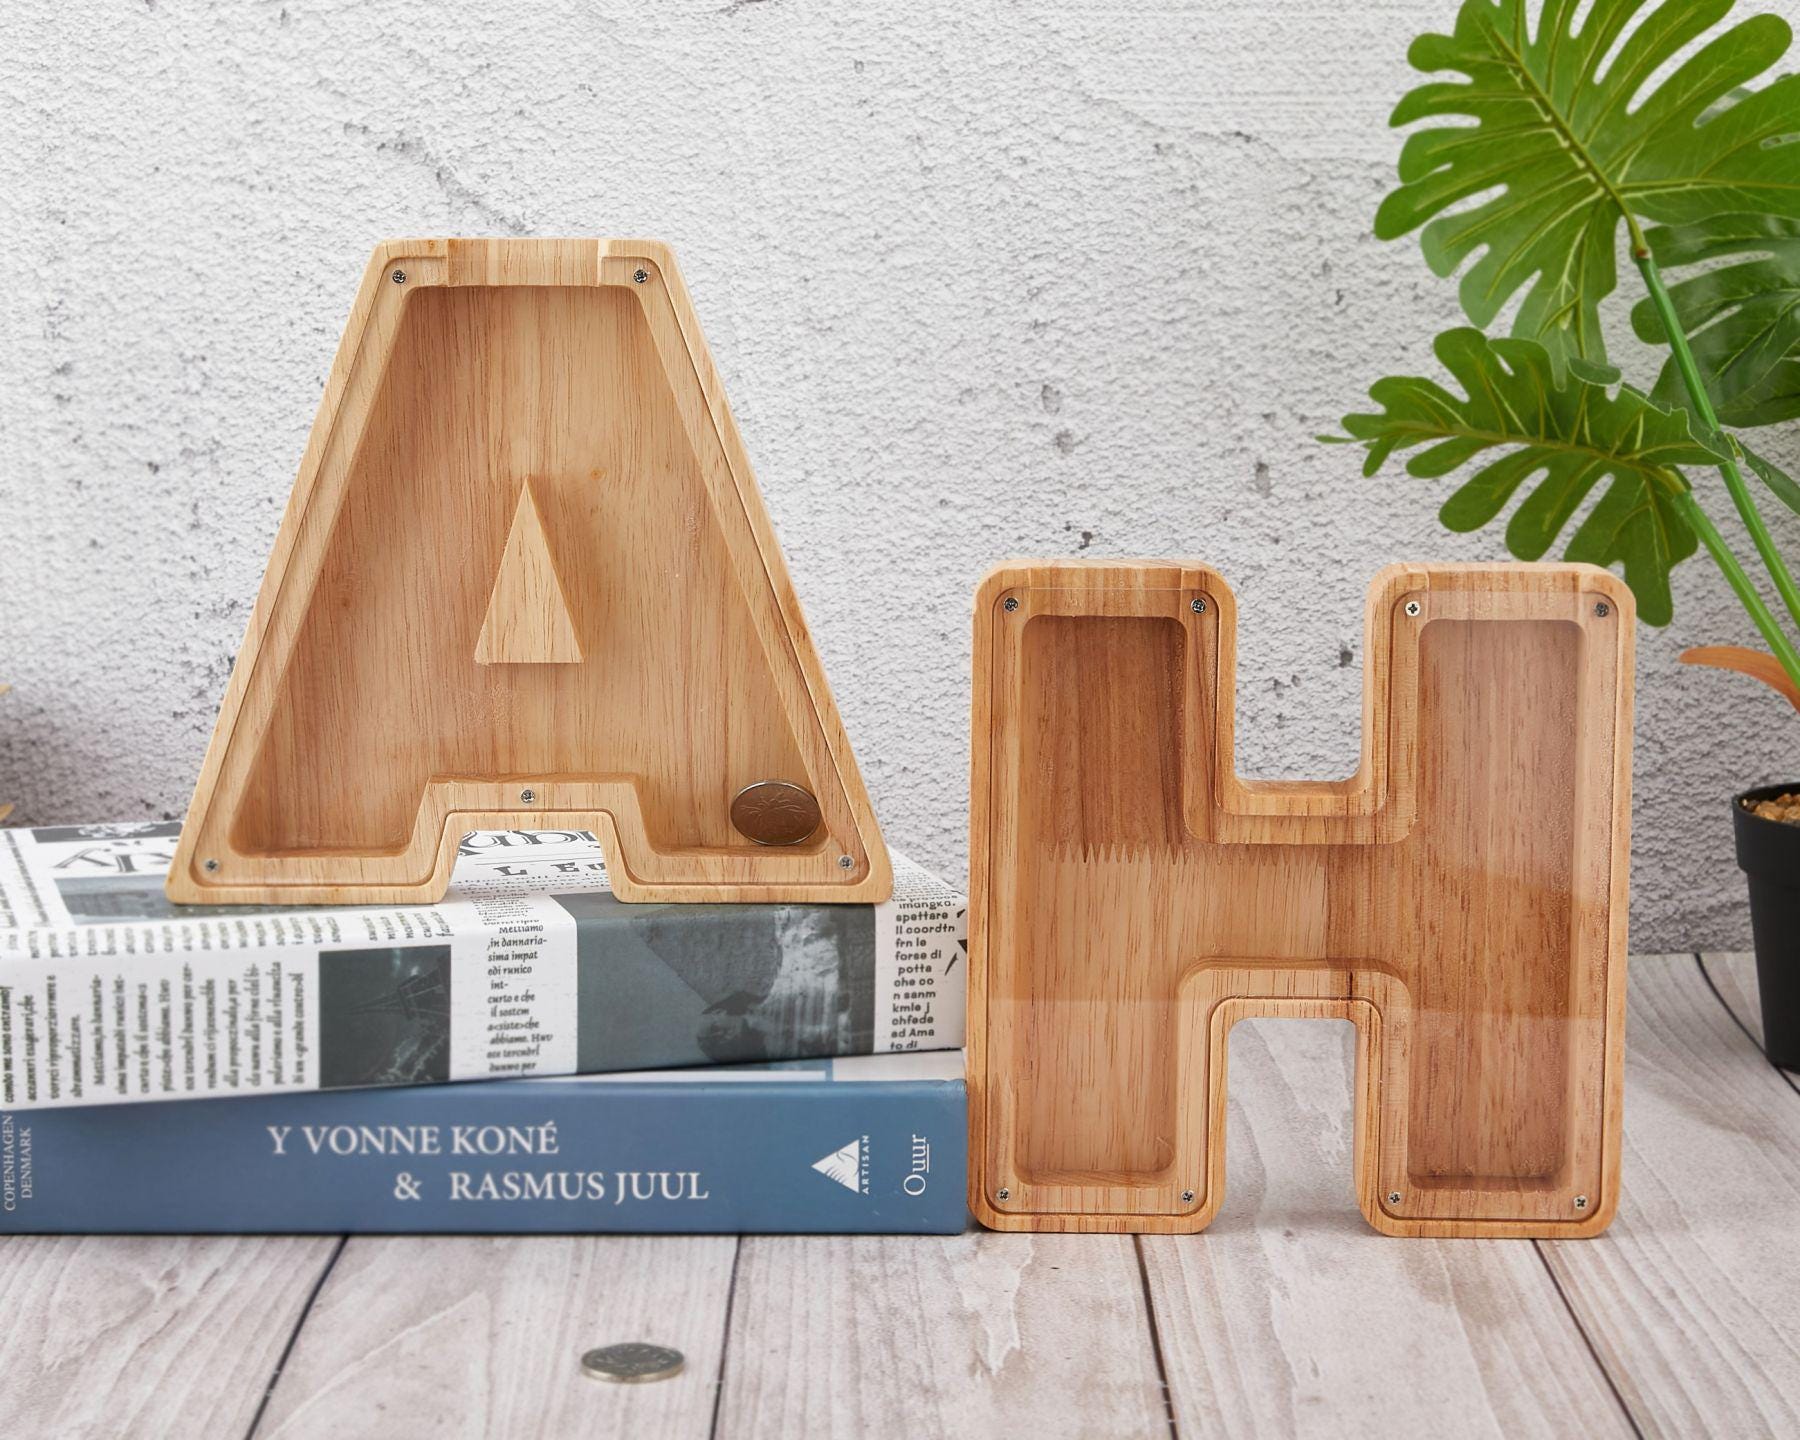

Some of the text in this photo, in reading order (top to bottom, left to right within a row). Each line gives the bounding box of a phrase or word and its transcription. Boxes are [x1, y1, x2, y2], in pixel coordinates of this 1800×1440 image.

[2, 1115, 16, 1211] COPENHAGEN
[19, 1127, 33, 1199] DENMARK
[302, 1126, 441, 1155] VONNE
[451, 1120, 560, 1155] KONÉ
[861, 1135, 870, 1195] ARTISAN
[393, 1172, 709, 1205] & RASMUS JUUL
